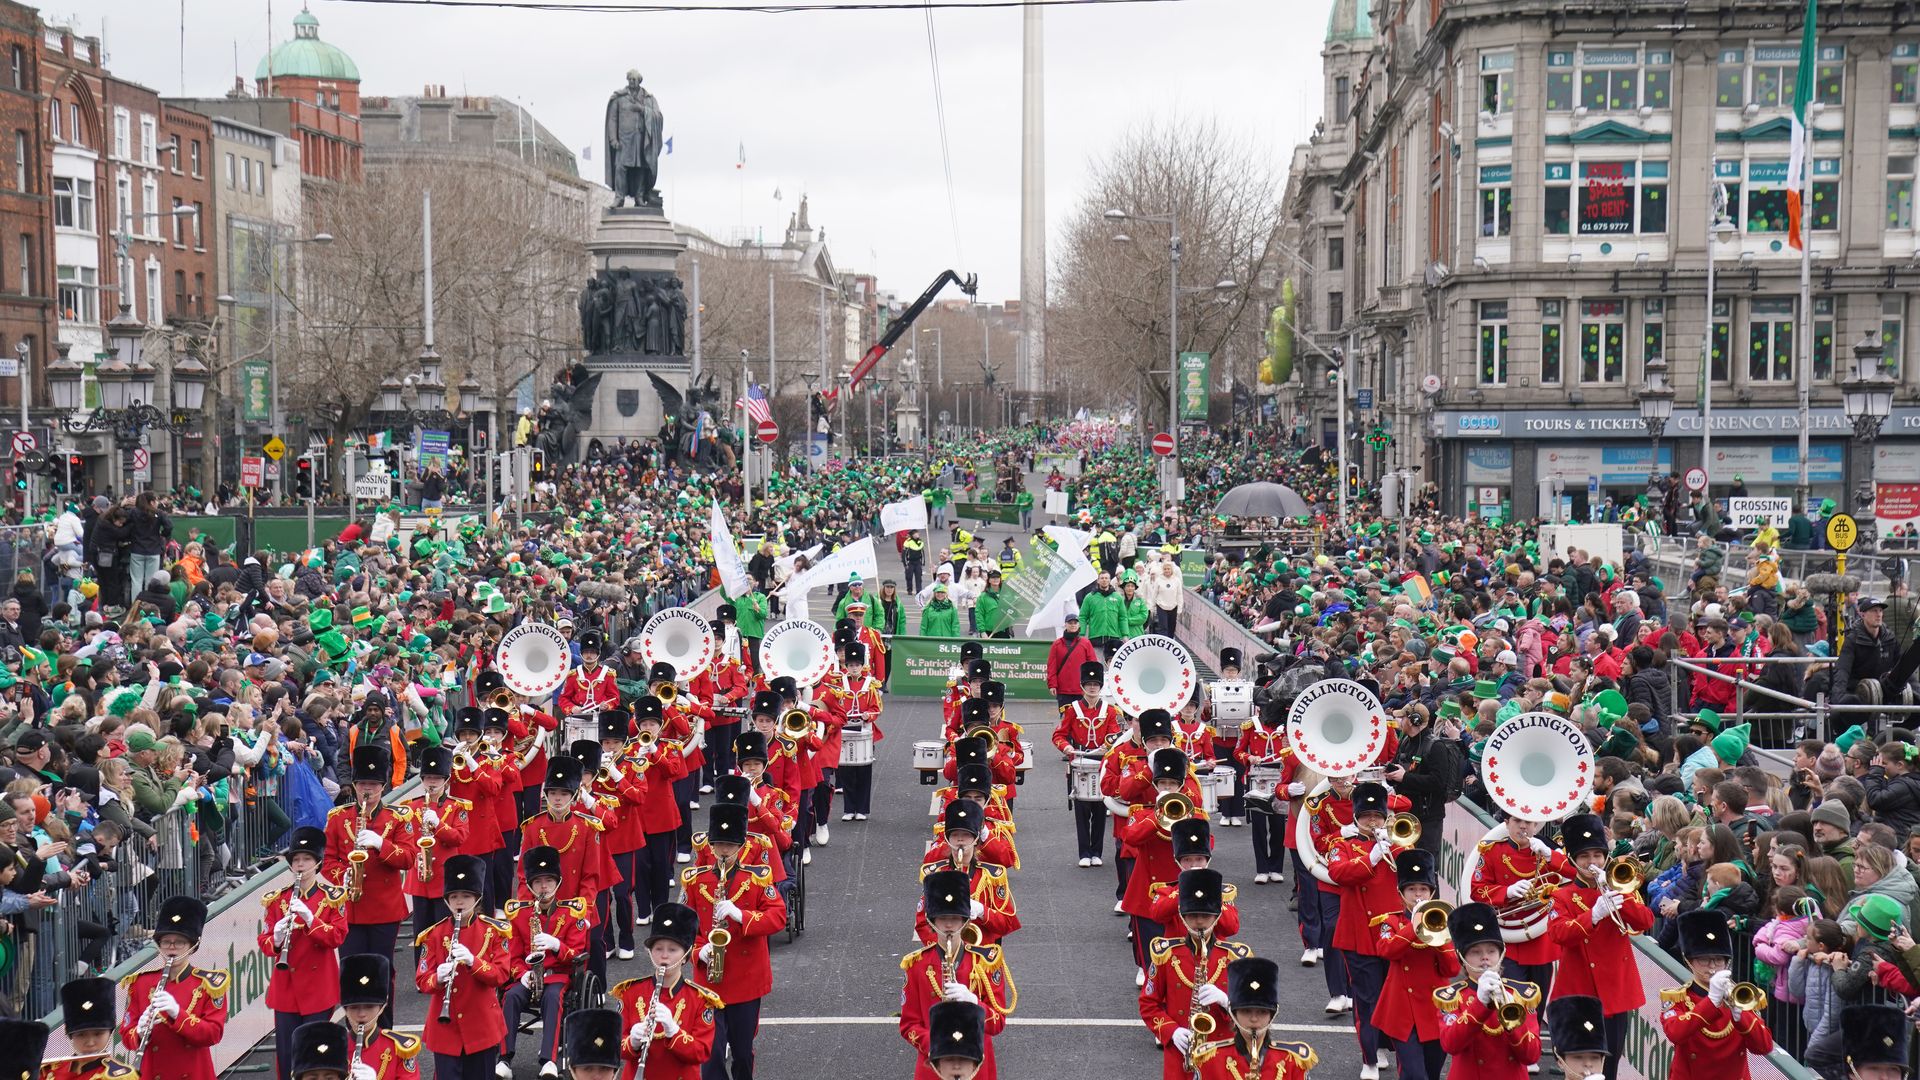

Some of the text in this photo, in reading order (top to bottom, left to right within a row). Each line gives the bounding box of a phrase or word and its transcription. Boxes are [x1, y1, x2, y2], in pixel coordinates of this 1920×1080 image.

[1584, 53, 1633, 64] Coworking
[1589, 179, 1624, 201] SPACE
[1586, 200, 1626, 218] TO RENT
[1525, 418, 1648, 430] TOURS & TICKETS
[1678, 415, 1776, 430] CURRENCY
[1688, 477, 1704, 485] TAXI
[357, 486, 386, 496] POINT H
[1734, 500, 1788, 511] CROSSING
[1777, 514, 1784, 524] H
[645, 607, 711, 636] BURLINGTON
[503, 625, 567, 650] BURLINGTON
[763, 620, 828, 650] BURLINGTON
[939, 644, 950, 653] St.
[990, 646, 1021, 655] Festival
[1113, 637, 1188, 670] BURLINGTON
[906, 659, 917, 667] St.
[919, 659, 957, 668] Patrick's
[994, 661, 1020, 669] Dance
[1021, 662, 1048, 671] Troup
[910, 668, 926, 676] and
[928, 668, 951, 677] Dubli
[1008, 671, 1048, 681] Academy
[1291, 682, 1377, 725] BURLINGTON
[1490, 716, 1588, 757] BURLINGTON
